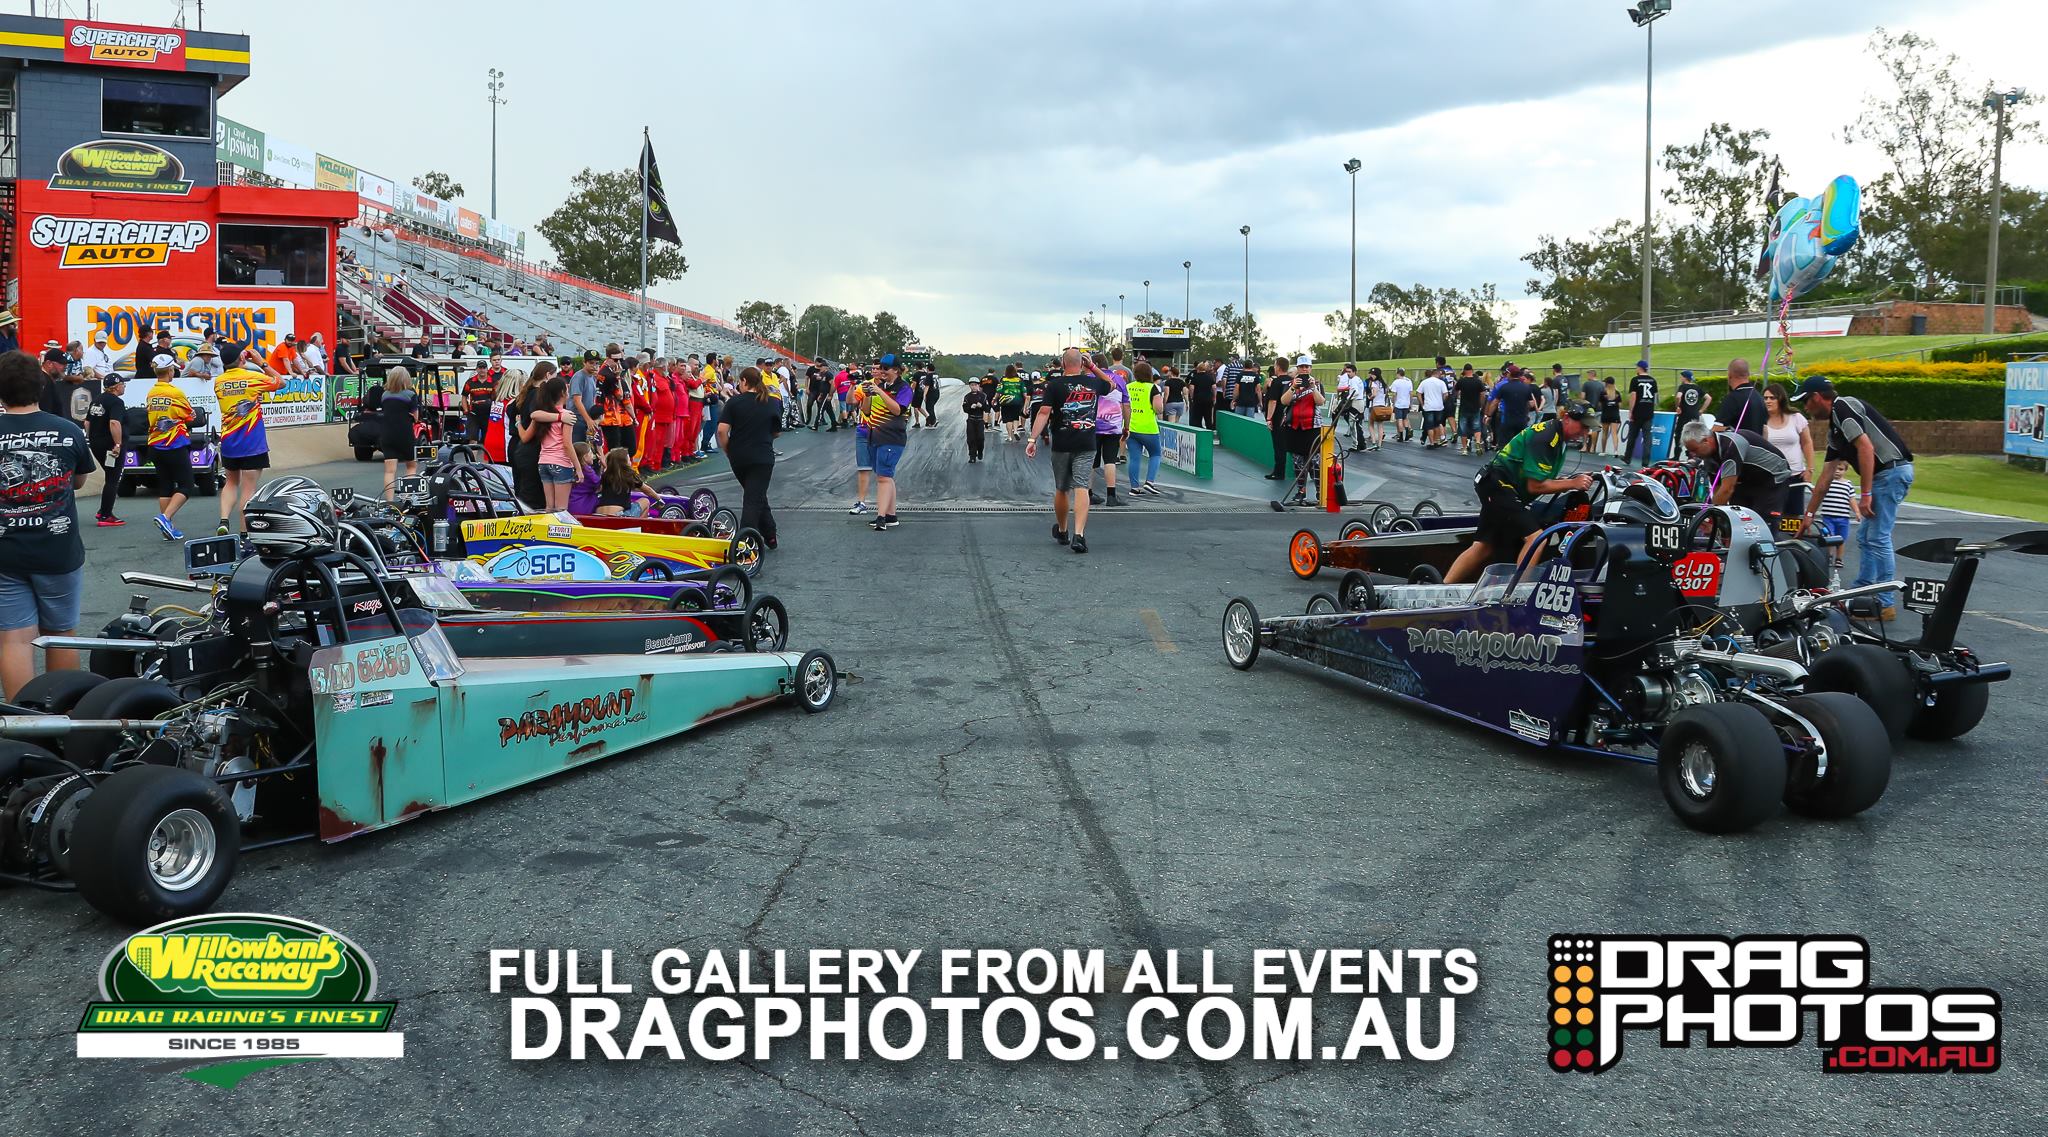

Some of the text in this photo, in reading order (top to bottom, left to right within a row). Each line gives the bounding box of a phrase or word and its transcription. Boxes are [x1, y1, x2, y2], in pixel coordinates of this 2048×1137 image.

[71, 27, 181, 52] SUPERCHEAP
[100, 48, 149, 56] AUTO
[227, 127, 259, 160] Ipswich
[71, 148, 167, 168] Willowbank
[104, 160, 160, 175] Raceway
[58, 178, 88, 186] DRAG
[92, 180, 143, 188] RACING'S
[32, 216, 209, 250] SUPERCHEAP
[77, 247, 155, 260] AUTO
[223, 381, 247, 389] SCG
[151, 397, 172, 406] SCG
[295, 404, 323, 413] MACHINING
[8, 517, 43, 527] 2010
[483, 522, 498, 537] 1031
[499, 518, 534, 541] Liezel
[1651, 525, 1680, 549] 8.40
[530, 553, 576, 576] SCG
[1549, 564, 1572, 583] A/JD
[1674, 559, 1715, 578] C/JD
[1535, 583, 1575, 613] 6263
[645, 633, 693, 651] Beauchamp
[674, 640, 707, 654] MOTORSPORT
[1406, 627, 1563, 663] PARAMOUNT
[1455, 650, 1582, 674] Performance
[498, 688, 636, 748] PARAMOUNT
